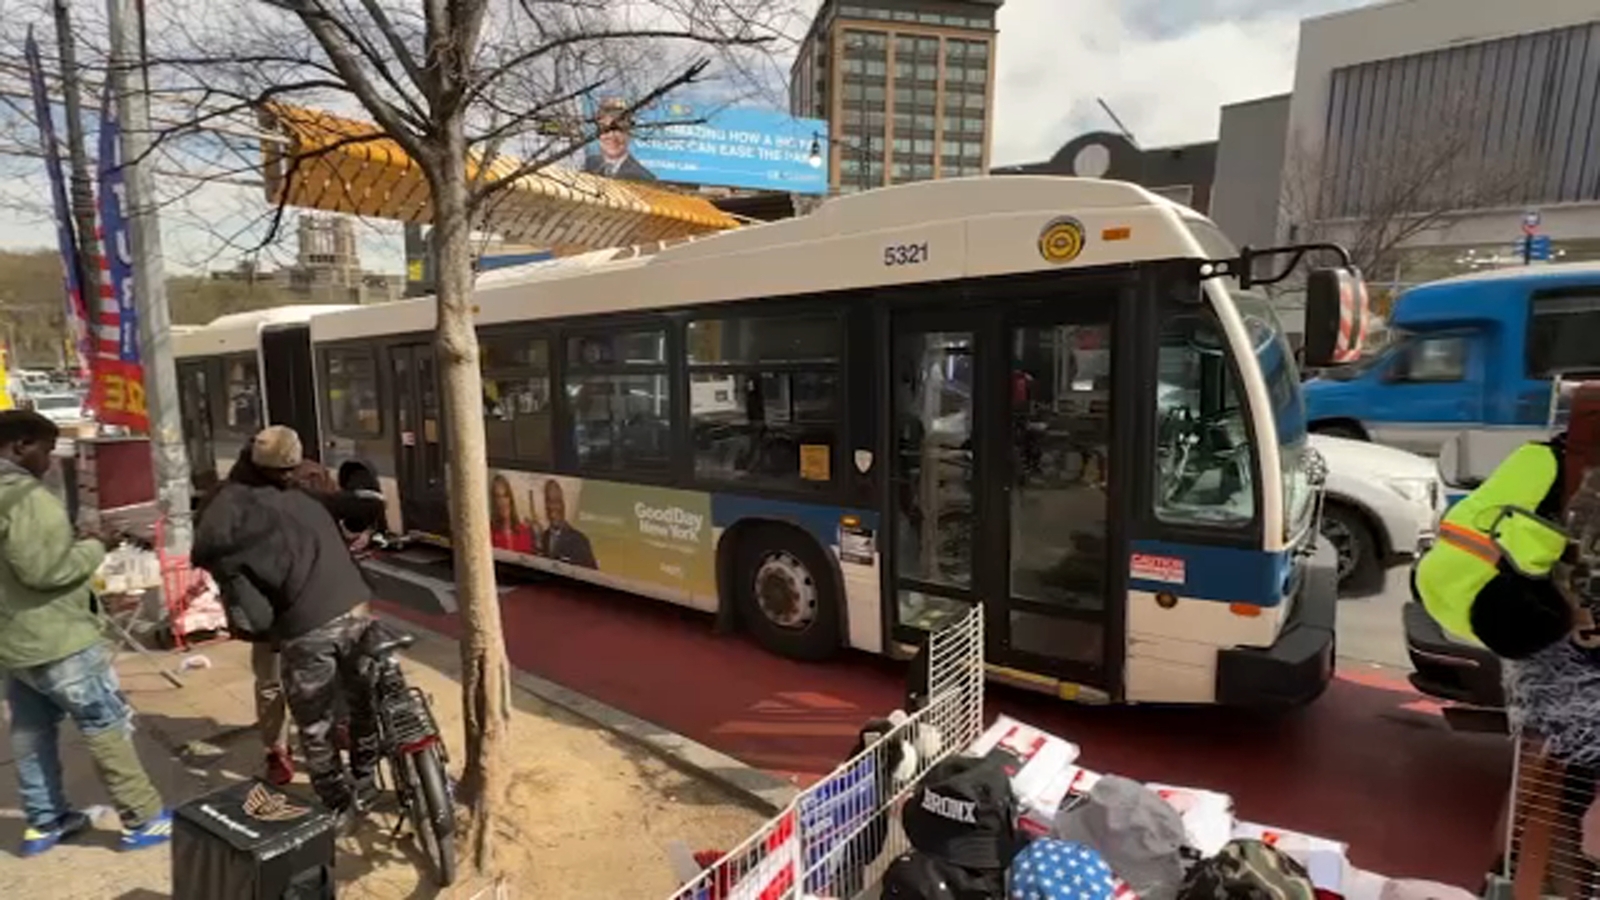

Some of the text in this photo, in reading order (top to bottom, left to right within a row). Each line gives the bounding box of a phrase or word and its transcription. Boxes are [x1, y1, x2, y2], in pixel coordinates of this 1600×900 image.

[729, 128, 761, 144] HOW
[762, 134, 773, 146] A
[686, 141, 717, 156] CAN
[719, 144, 757, 159] EASE
[758, 147, 781, 161] THE
[884, 241, 929, 267] 5321
[634, 501, 703, 532] GoodDay
[669, 523, 700, 544] York
[921, 786, 978, 824] BRONX
